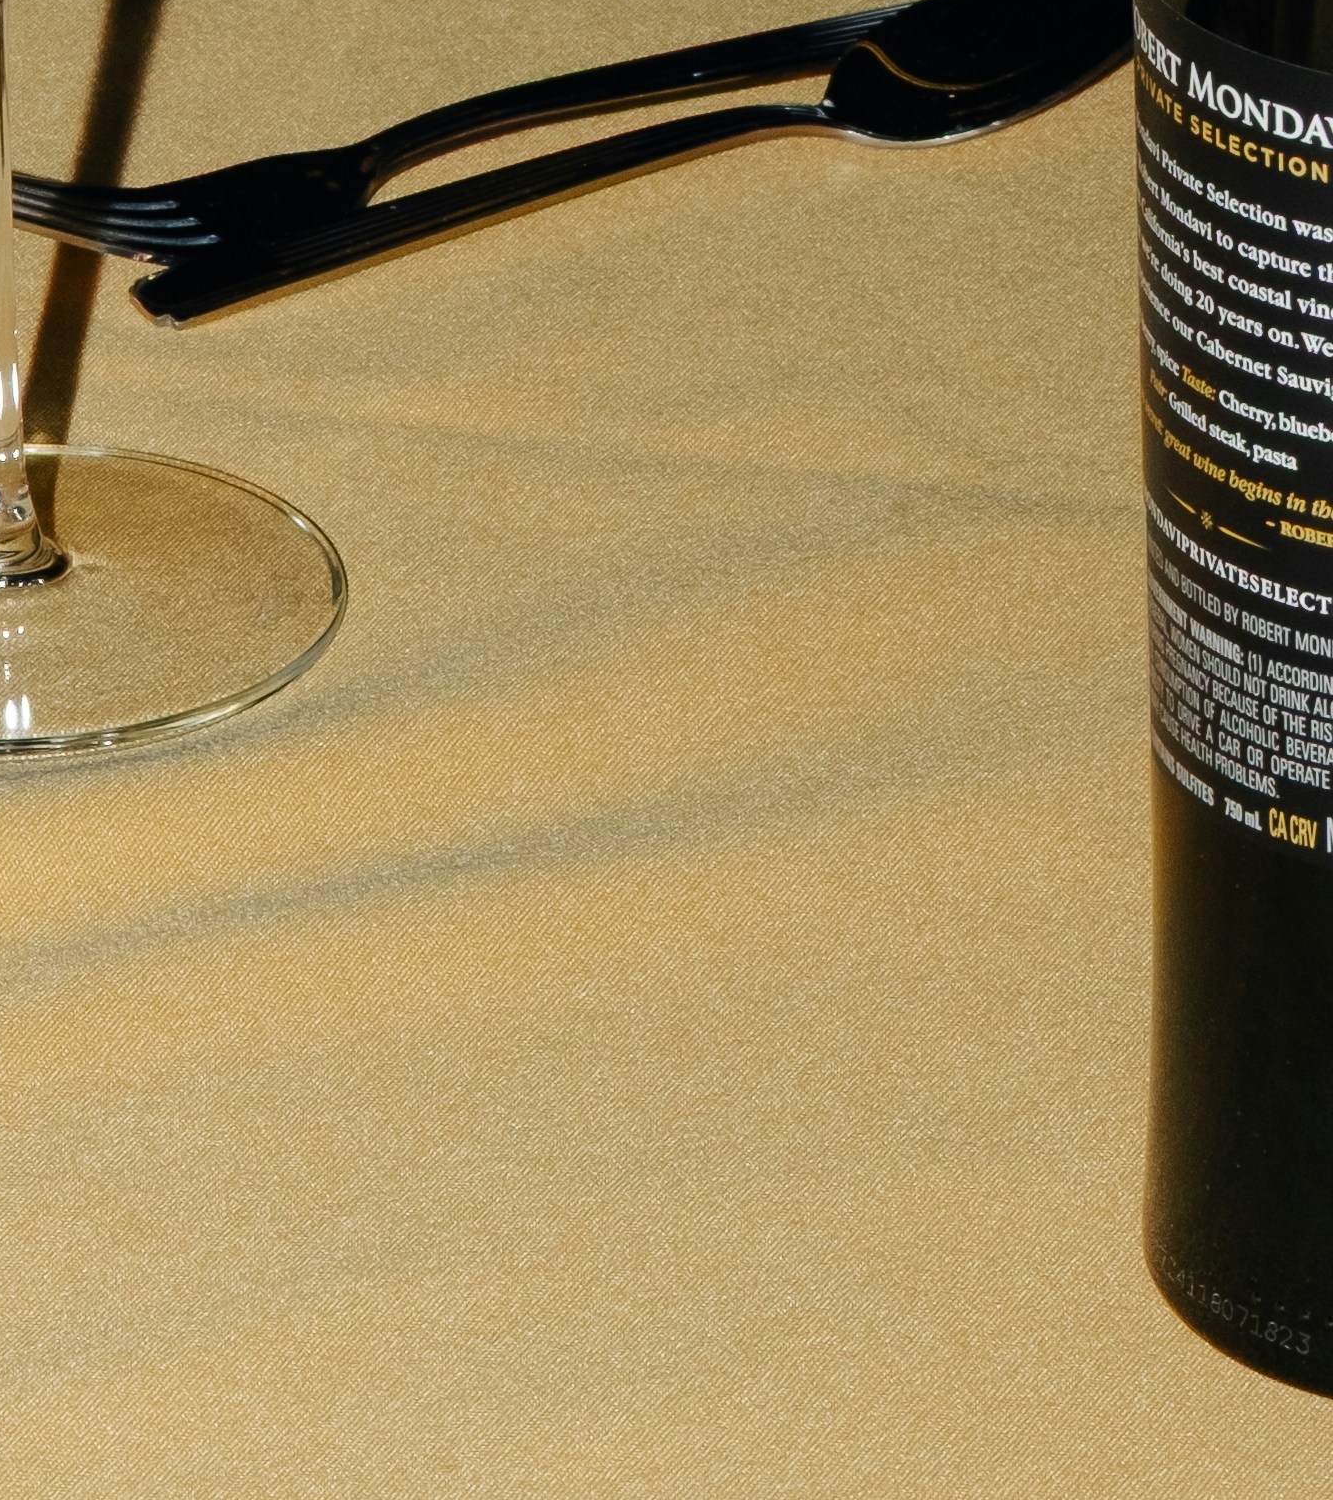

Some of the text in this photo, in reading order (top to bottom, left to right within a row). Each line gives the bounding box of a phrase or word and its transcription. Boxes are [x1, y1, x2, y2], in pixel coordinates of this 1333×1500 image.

[1190, 114, 1329, 184] SELECTION
[1161, 149, 1204, 195] Private
[1206, 182, 1288, 232] Selection
[1292, 219, 1333, 243] was
[1161, 187, 1213, 241] Mondavi
[1215, 229, 1234, 250] to
[1237, 242, 1312, 278] capture
[1160, 263, 1193, 306] doing
[1195, 289, 1214, 314] 20
[1217, 305, 1263, 338] years
[1267, 327, 1300, 349] on.
[1300, 331, 1333, 358] We
[1192, 249, 1225, 284] best
[1228, 274, 1292, 310] coastal
[1171, 315, 1195, 342] our
[1196, 330, 1272, 380] Cabernet
[1276, 365, 1333, 402] Sauvi
[1168, 391, 1208, 432] Grilled
[1208, 423, 1251, 457] steak,
[1252, 443, 1299, 471] pasta
[1181, 364, 1217, 401] Taste:
[1218, 389, 1276, 431] Cherry,
[1163, 429, 1192, 461] great
[1193, 452, 1226, 482] wine
[1228, 469, 1283, 506] begins
[1286, 492, 1307, 513] in
[1180, 573, 1222, 617] BOTTLED
[1223, 602, 1239, 626] BY
[1241, 611, 1292, 647] ROBERT
[1295, 630, 1333, 659] MON
[1189, 616, 1244, 666] WARNING:
[1247, 650, 1264, 677] (1)
[1201, 649, 1241, 688] SHOULD
[1243, 672, 1268, 700] NOT
[1270, 683, 1311, 714] DRINK
[1212, 680, 1259, 721] BECAUSE
[1262, 704, 1279, 727] OF
[1281, 710, 1307, 737] THE
[1203, 698, 1216, 721] OF
[1219, 709, 1280, 752] ALCOHOLIC
[1205, 723, 1214, 745] A
[1218, 731, 1241, 759] CAR
[1247, 745, 1264, 769] OR
[1270, 755, 1331, 790] OPERATE
[1180, 726, 1213, 767] HEALTH
[1215, 752, 1280, 799] PROBLEMS.
[1175, 761, 1215, 806] SULFITES
[1224, 796, 1243, 822] 750
[1244, 810, 1263, 831] mL
[1268, 807, 1288, 841] CA
[1289, 814, 1318, 849] CRV
